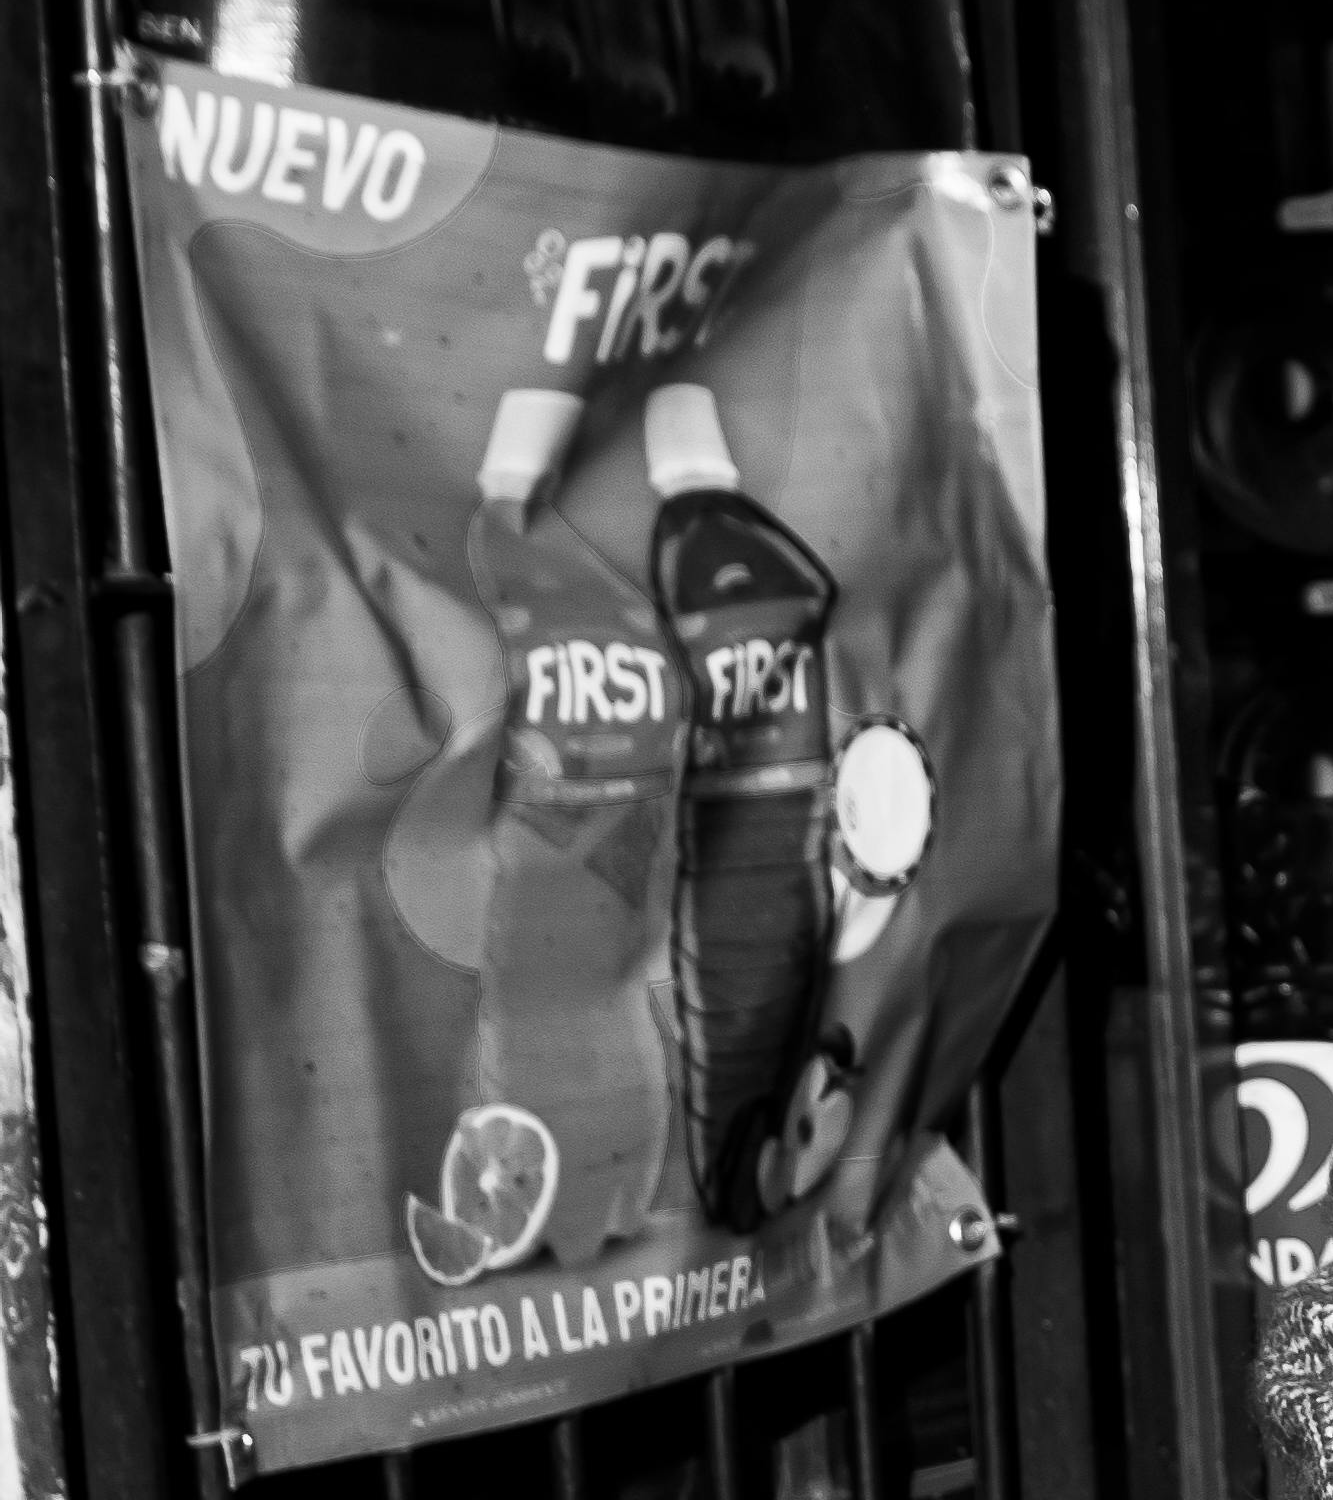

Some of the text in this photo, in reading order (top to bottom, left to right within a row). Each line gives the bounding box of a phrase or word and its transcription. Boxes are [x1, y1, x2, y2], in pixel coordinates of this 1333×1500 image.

[159, 84, 427, 223] NUEVO
[239, 1339, 293, 1412] TU
[300, 1300, 511, 1399] FAVORITO
[520, 1291, 549, 1362] A
[554, 1279, 608, 1353] LA
